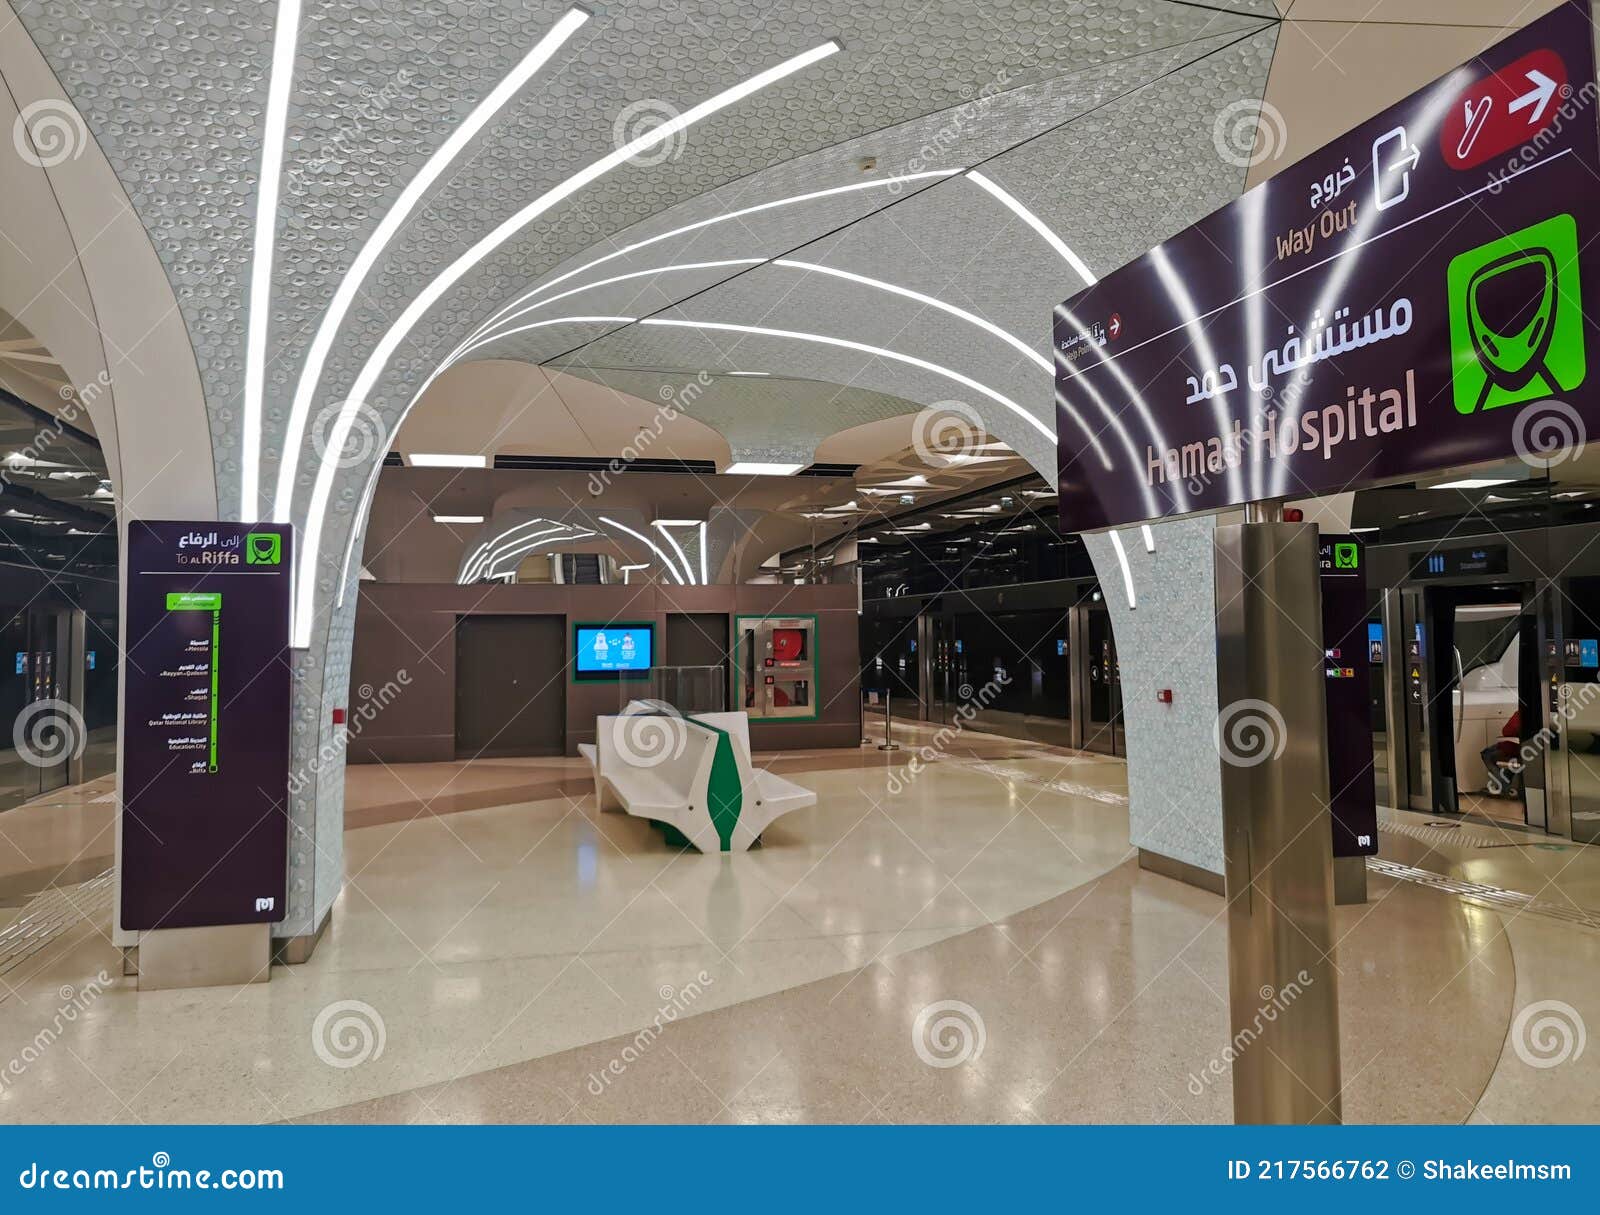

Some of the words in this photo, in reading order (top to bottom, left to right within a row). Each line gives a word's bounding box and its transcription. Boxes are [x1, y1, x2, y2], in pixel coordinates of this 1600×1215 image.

[1310, 157, 1356, 209] خروج
[1276, 224, 1315, 260] Way
[1320, 199, 1358, 239] Out
[1186, 363, 1238, 405] حمد
[1147, 419, 1242, 487] Hamad
[1254, 369, 1417, 462] Hospital
[176, 553, 188, 564] To
[201, 551, 240, 565] Riffa
[178, 532, 217, 548] الرفاع
[221, 535, 240, 548] إلى
